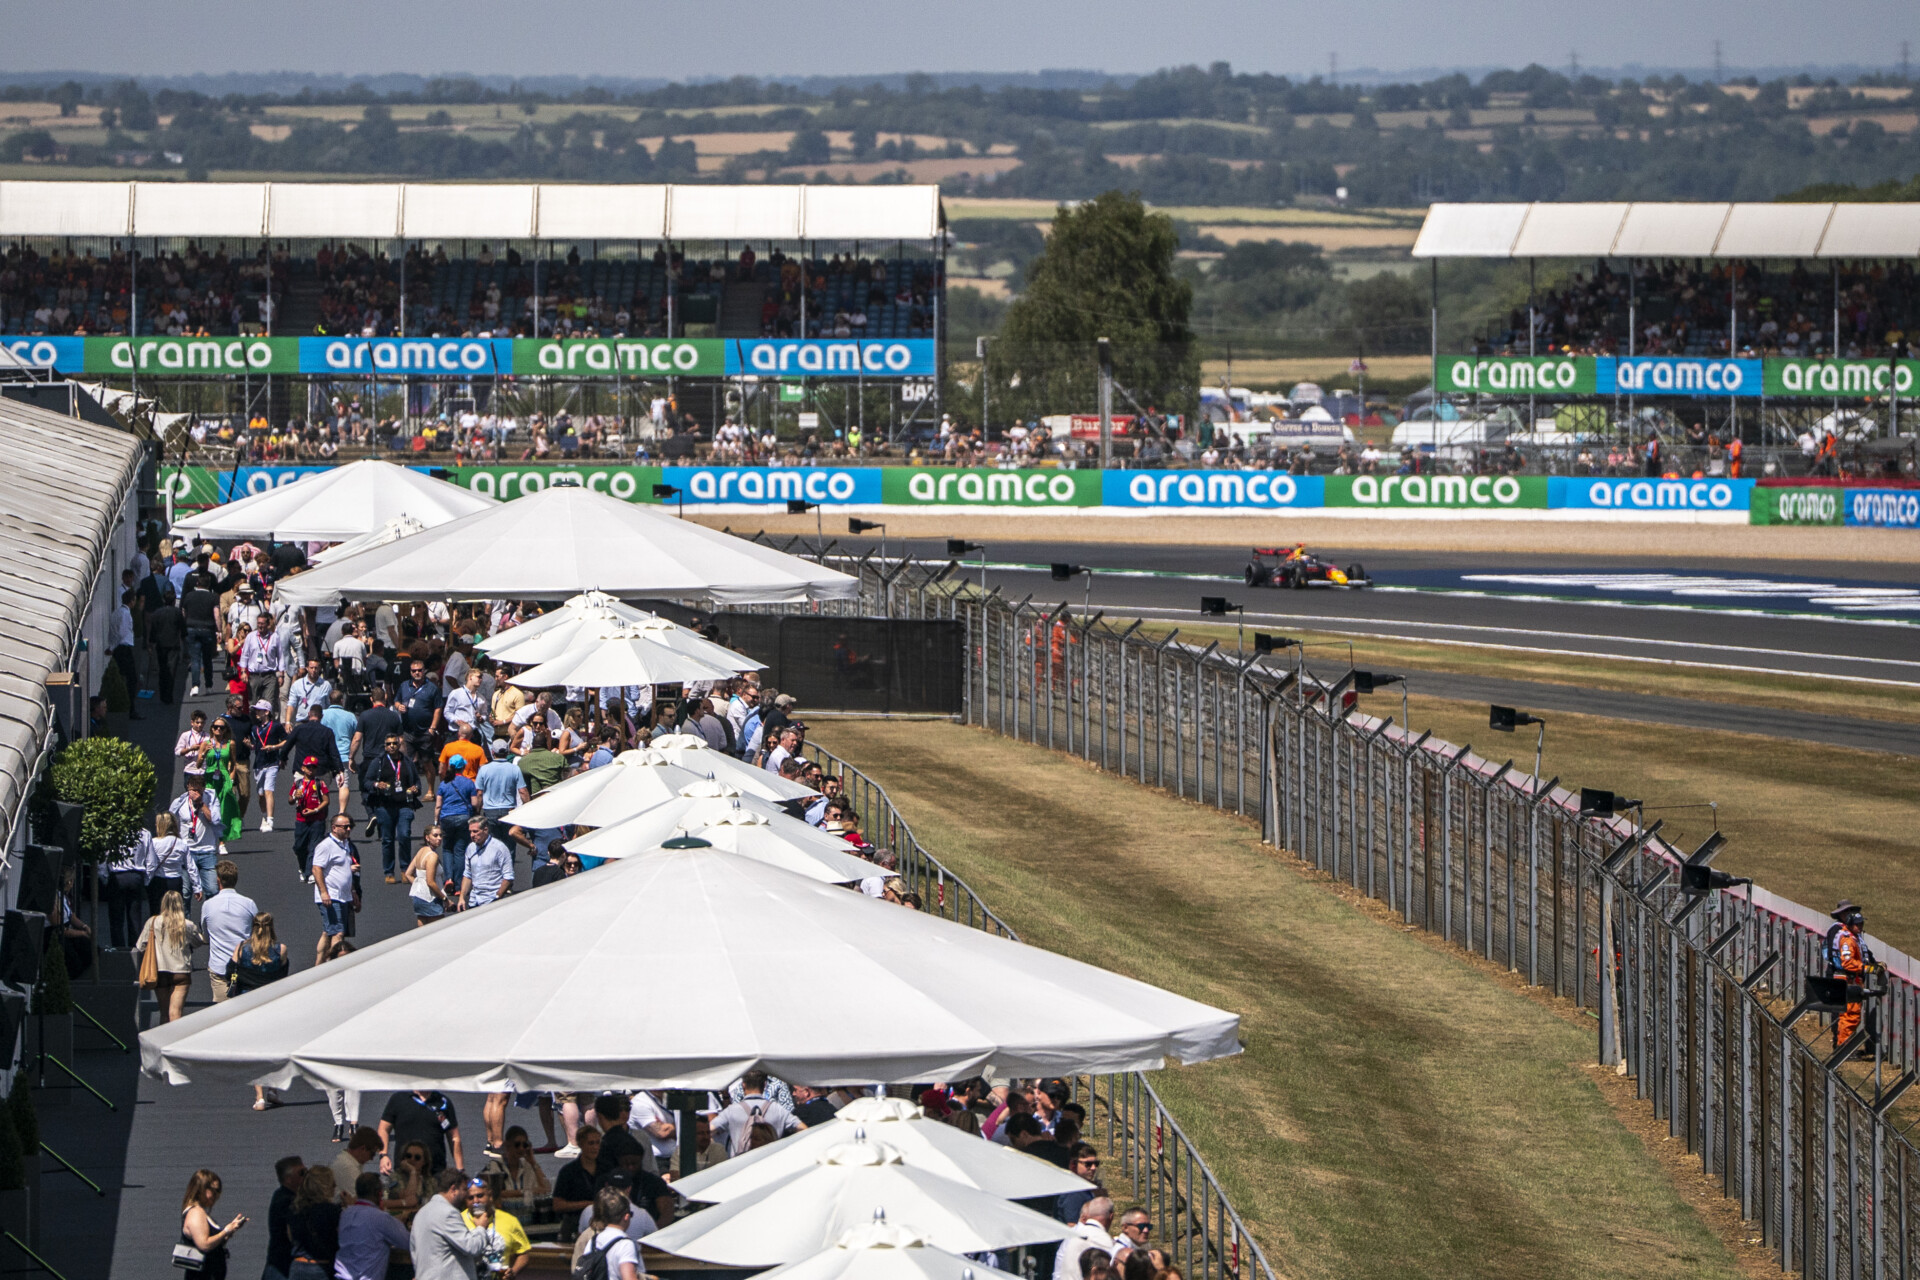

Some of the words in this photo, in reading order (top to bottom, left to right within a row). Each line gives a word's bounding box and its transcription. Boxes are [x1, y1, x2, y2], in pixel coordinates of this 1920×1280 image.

[111, 342, 273, 368] aramco
[325, 342, 487, 369] aramco
[538, 343, 699, 370] aramco
[751, 344, 911, 370] aramco
[1451, 361, 1577, 389] aramco
[1617, 362, 1743, 390] aramco
[1781, 364, 1913, 392] aramco
[689, 472, 855, 500] aramco
[908, 473, 1076, 502] aramco
[1129, 475, 1297, 503] aramco
[1351, 475, 1521, 504] aramco
[1589, 482, 1733, 507] aramco
[1779, 493, 1836, 521] aramco
[1853, 494, 1919, 523] aramco
